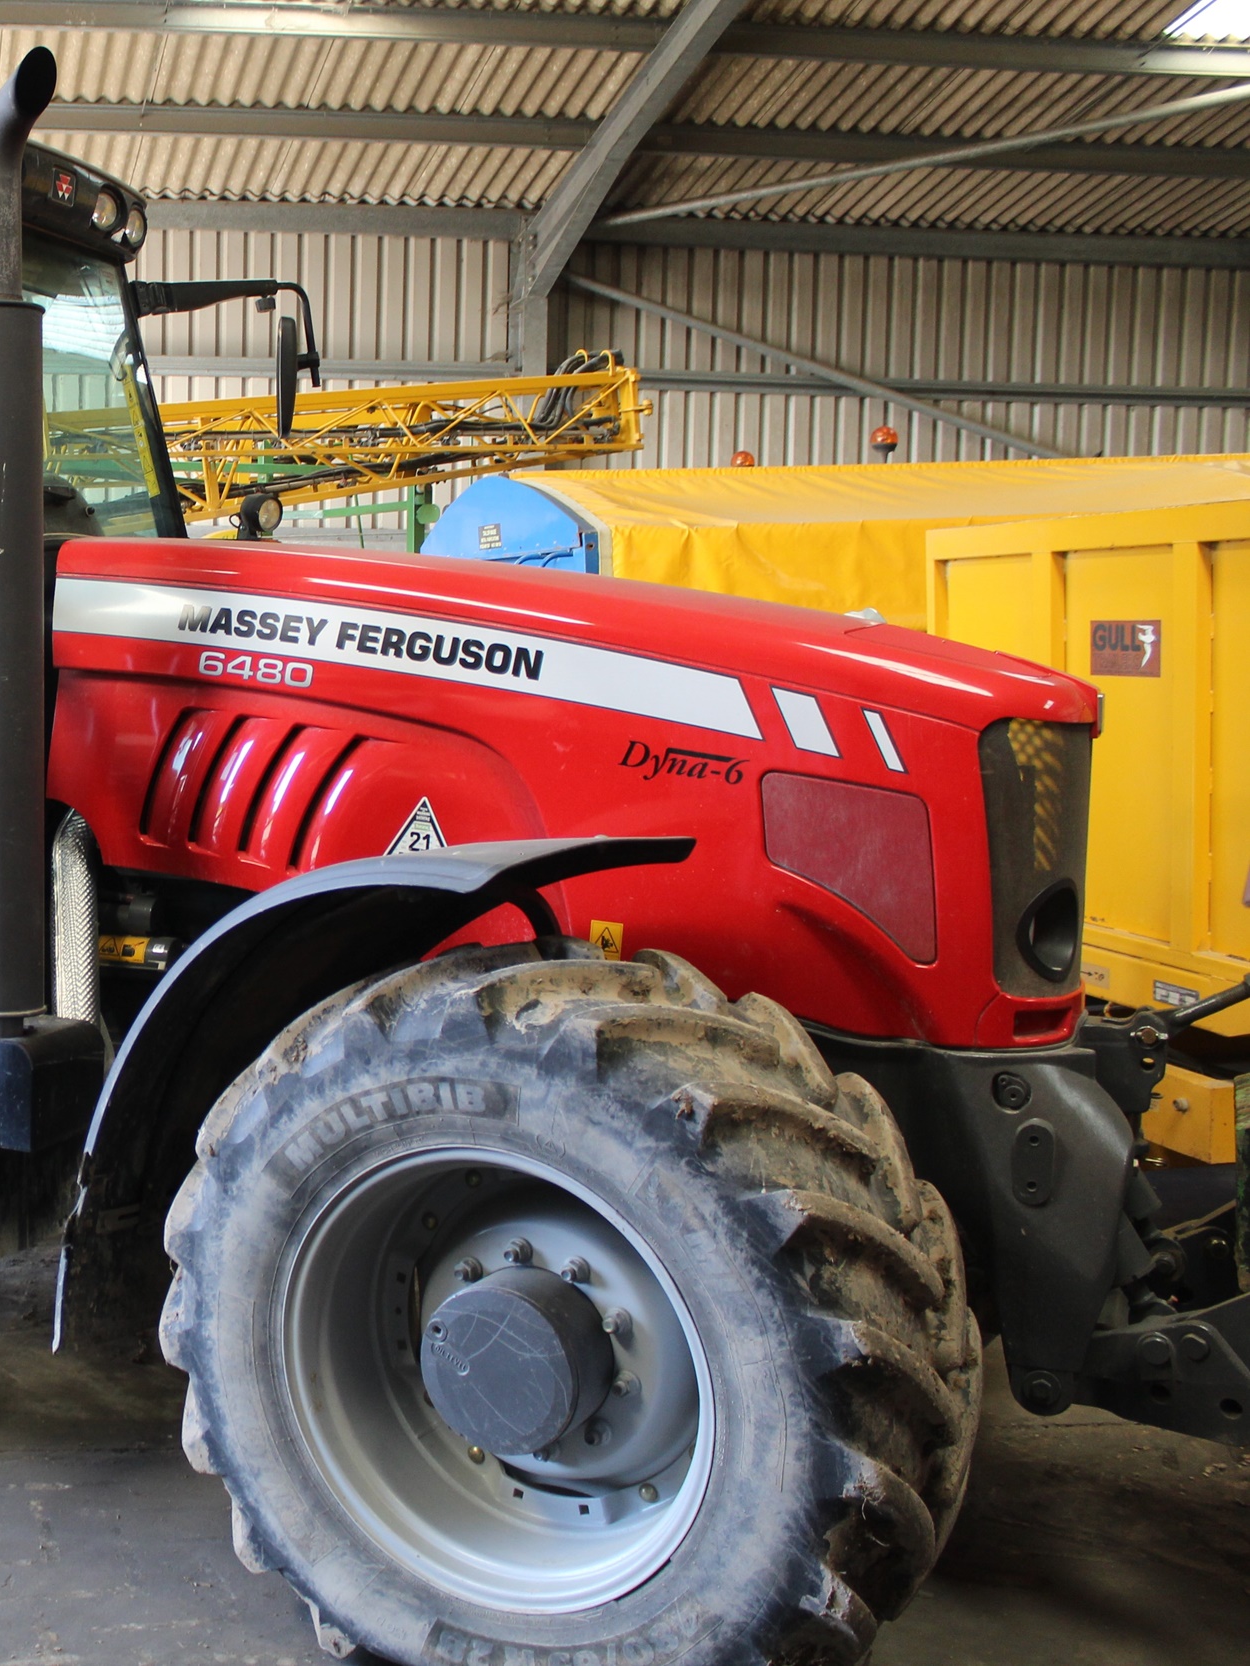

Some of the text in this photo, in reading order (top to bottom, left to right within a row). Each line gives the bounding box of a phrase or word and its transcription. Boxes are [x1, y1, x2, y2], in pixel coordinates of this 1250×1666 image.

[177, 604, 544, 681] MASSEY FERGUSON
[1093, 624, 1141, 652] GULL
[199, 651, 314, 688] 6480
[618, 740, 750, 785] Dyna-6
[408, 831, 431, 851] 21
[284, 1082, 486, 1170] MULTIBIB
